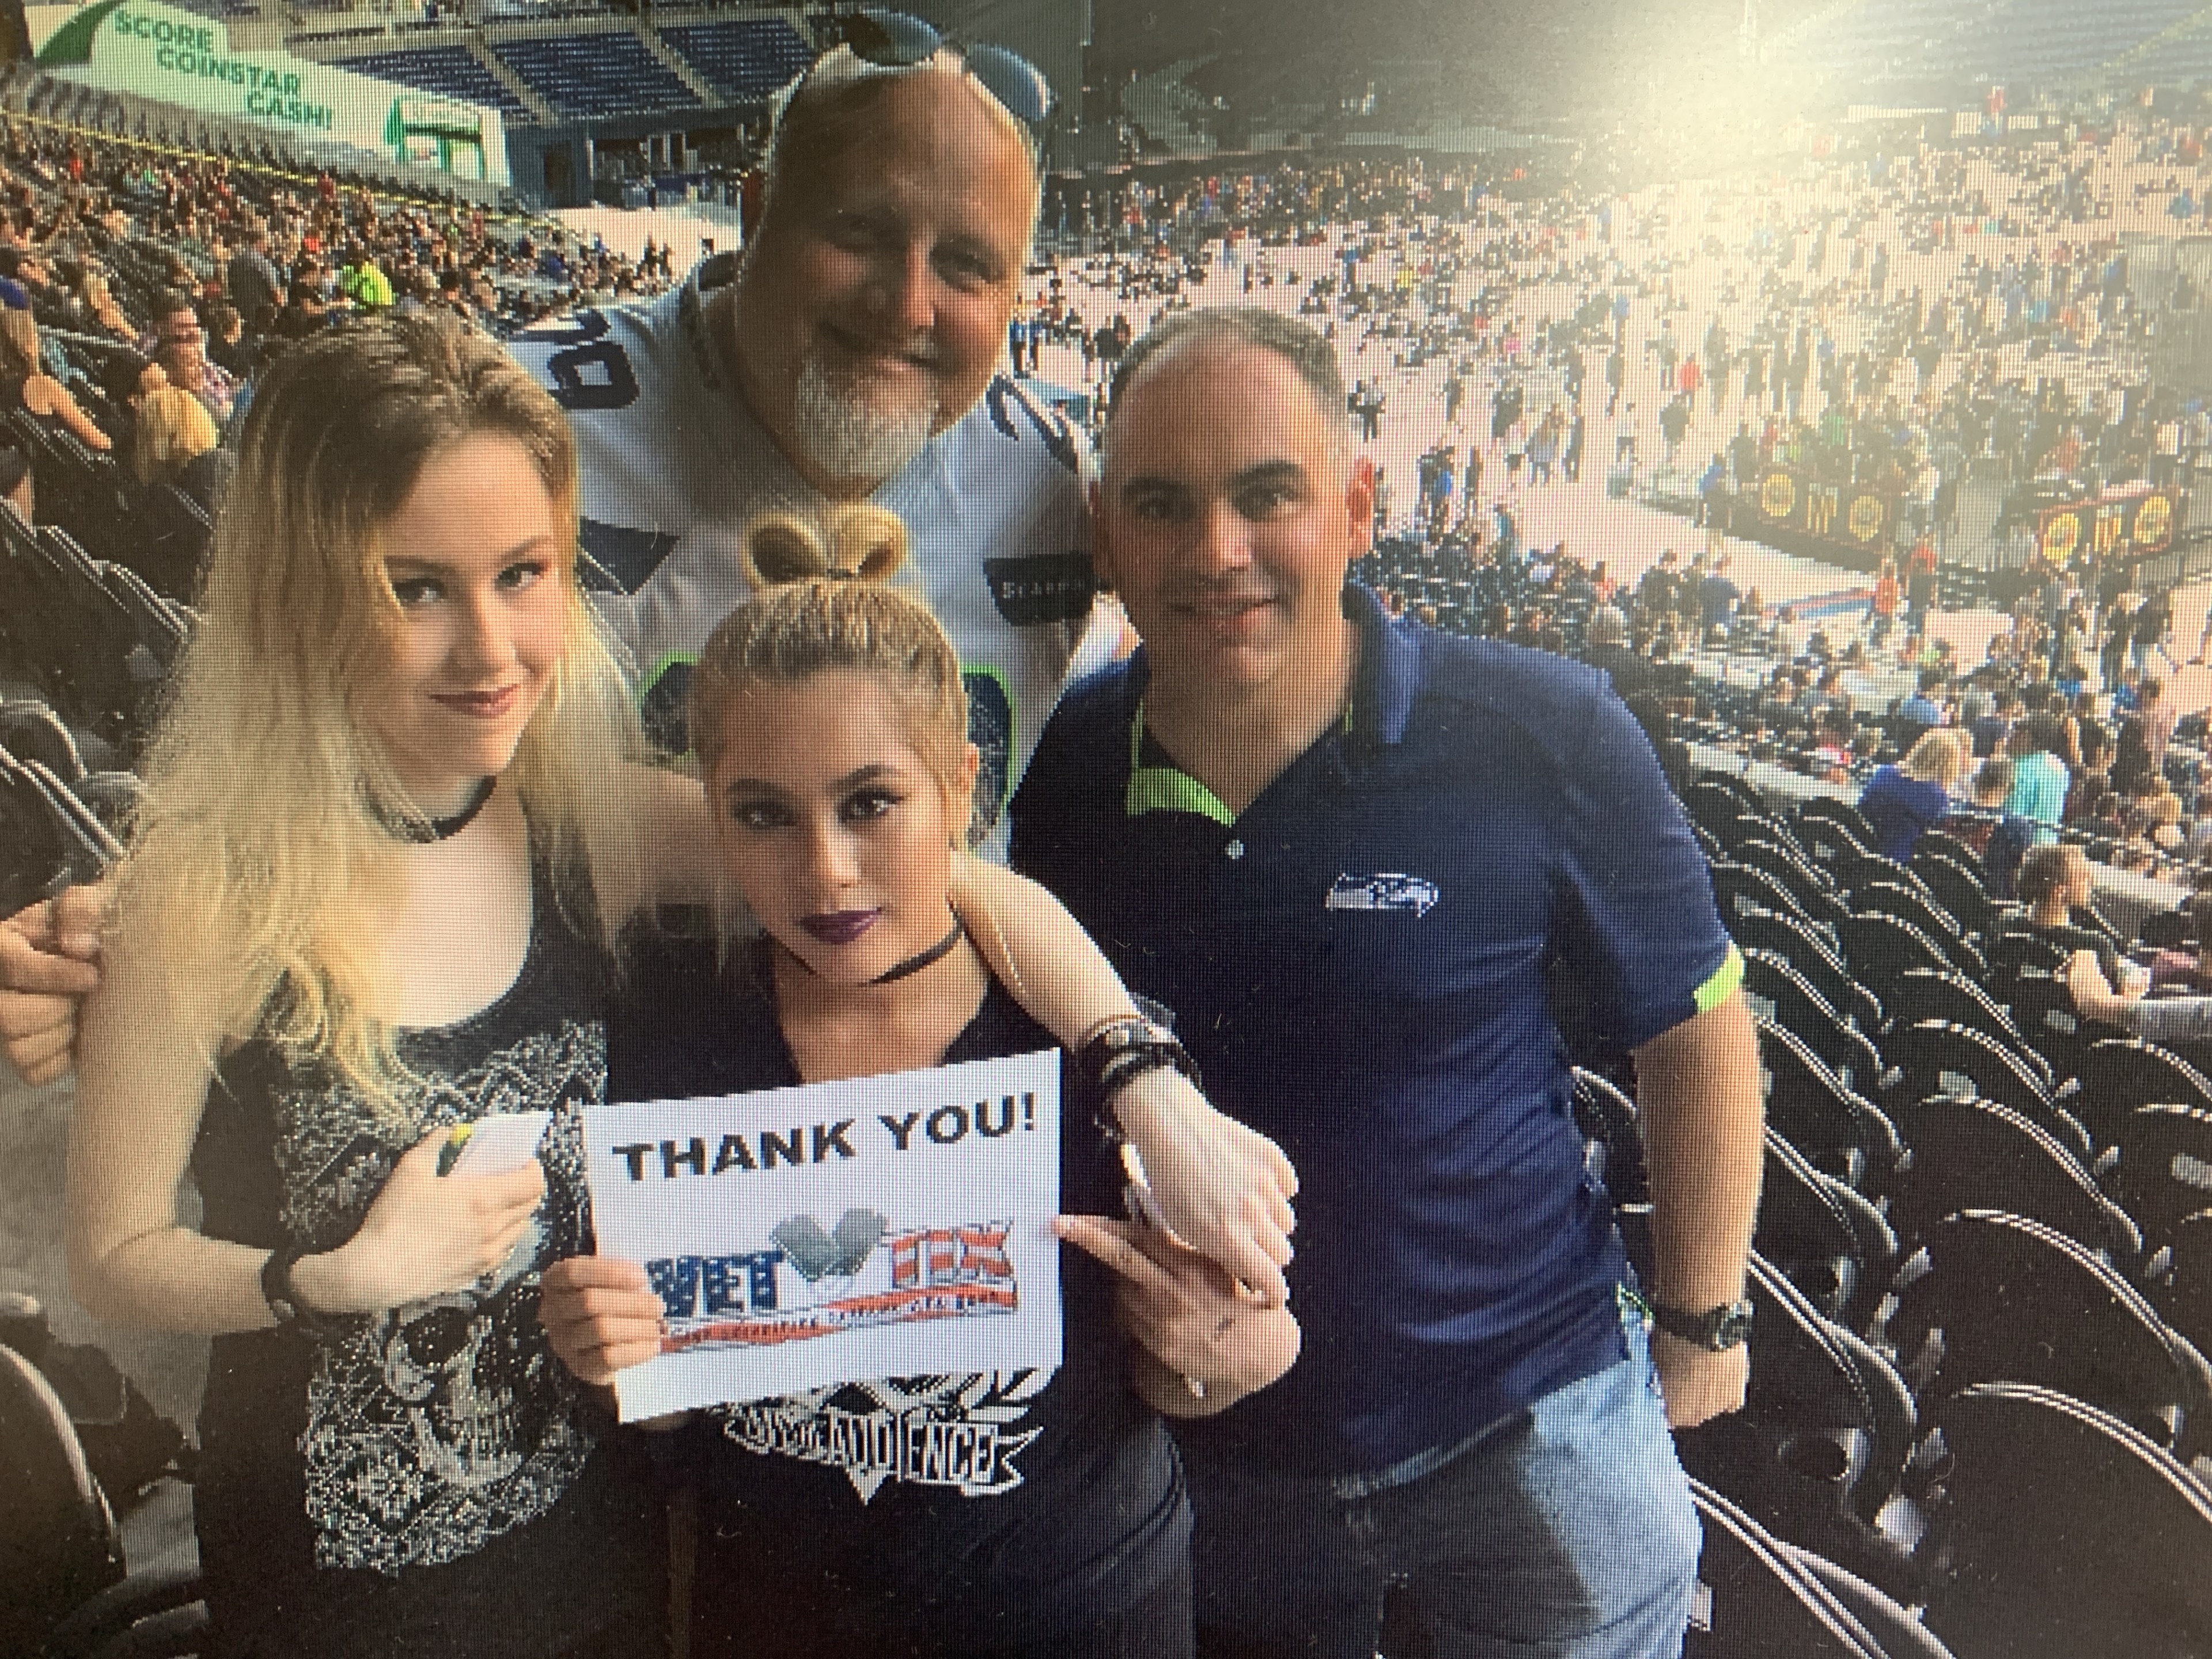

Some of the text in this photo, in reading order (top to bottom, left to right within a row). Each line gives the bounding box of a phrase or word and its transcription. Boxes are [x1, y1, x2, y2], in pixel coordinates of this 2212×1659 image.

[115, 10, 214, 52] SCORE
[157, 46, 300, 96] COINSTAR
[246, 91, 334, 131] CASH!
[613, 1092, 1036, 1181] THANK YOU!
[646, 1251, 785, 1318] VET
